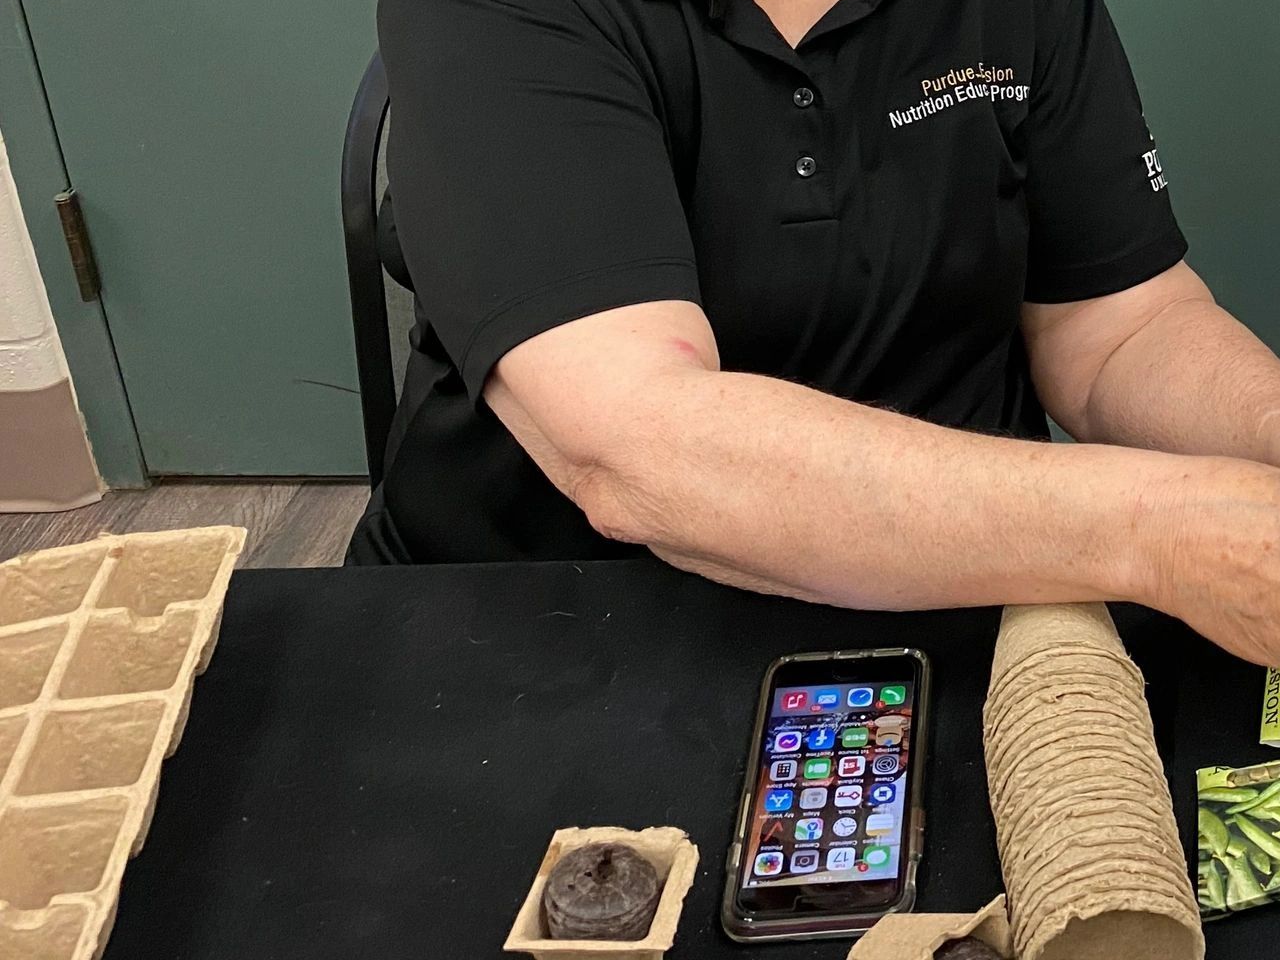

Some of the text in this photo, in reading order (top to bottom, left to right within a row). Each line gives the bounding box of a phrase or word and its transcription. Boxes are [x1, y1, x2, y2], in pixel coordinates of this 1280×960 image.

[921, 67, 975, 97] Purdue
[889, 94, 954, 128] Nutrition
[1141, 149, 1162, 177] PU
[833, 852, 850, 863] 17
